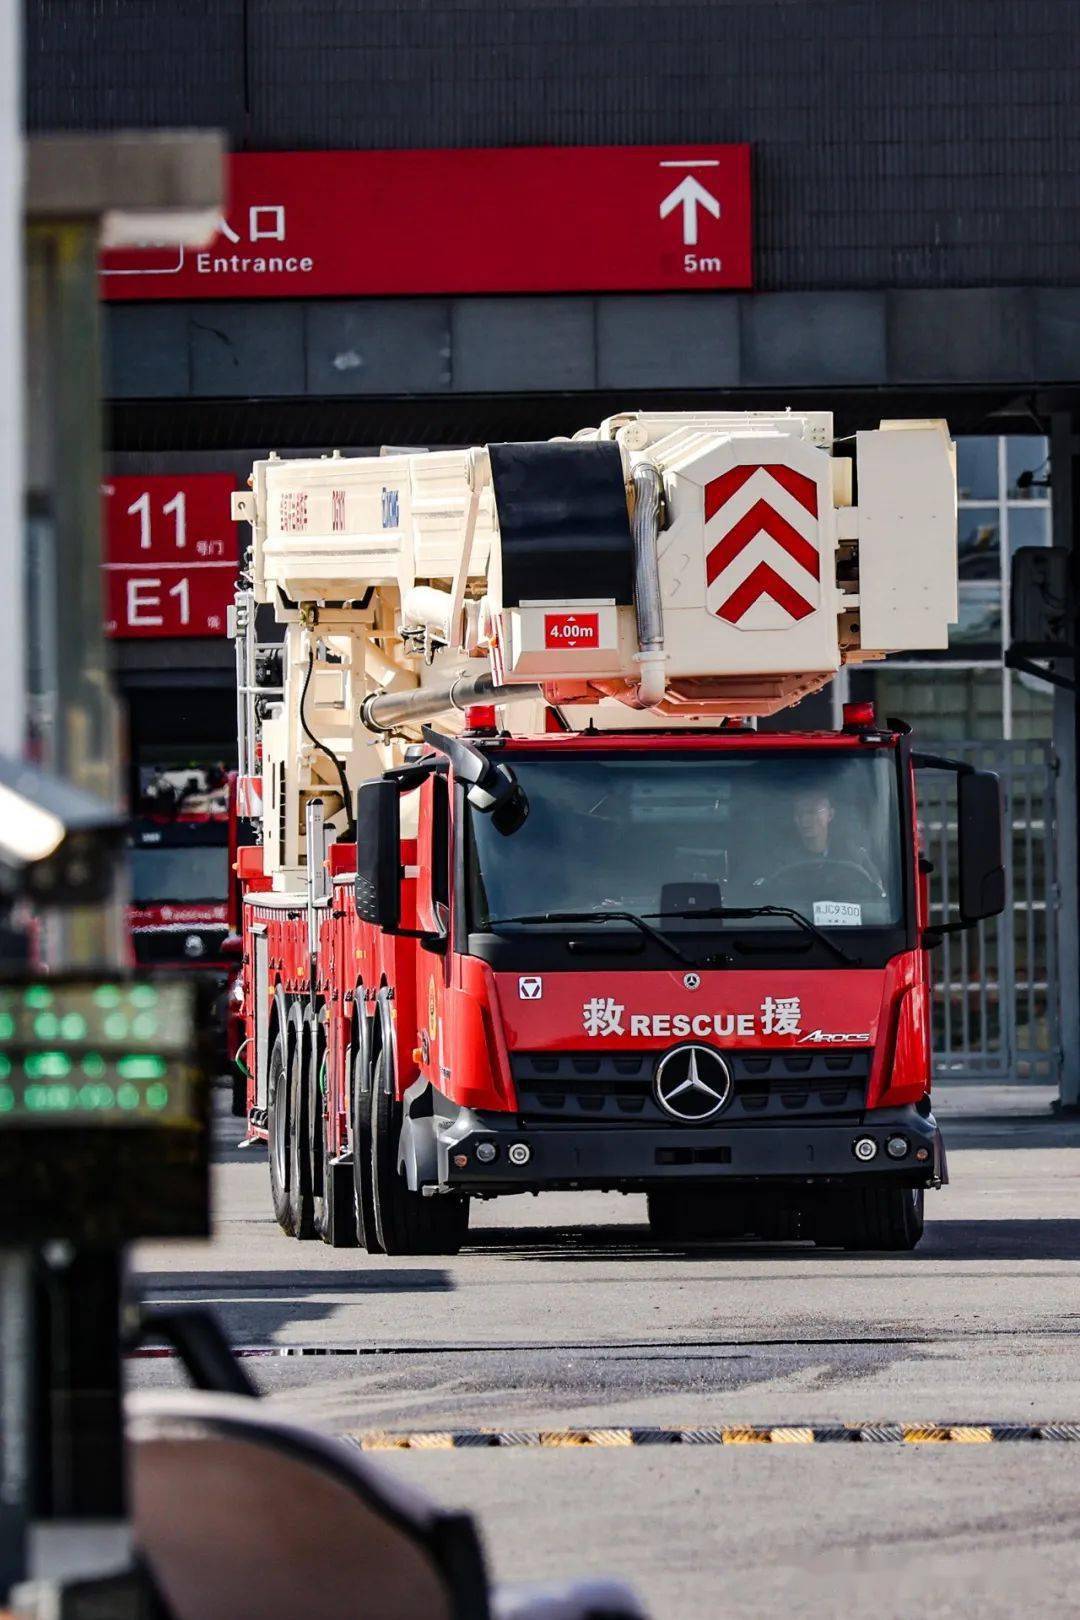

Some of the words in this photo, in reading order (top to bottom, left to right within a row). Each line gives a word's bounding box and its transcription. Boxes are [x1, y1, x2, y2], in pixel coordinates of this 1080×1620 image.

[197, 253, 314, 274] Entrance
[683, 253, 722, 273] 5m
[126, 491, 187, 550] 11
[126, 577, 190, 627] E1
[549, 624, 594, 638] 4.00m
[583, 997, 625, 1037] 救
[630, 1014, 756, 1037] RESCUE
[760, 996, 802, 1035] 援
